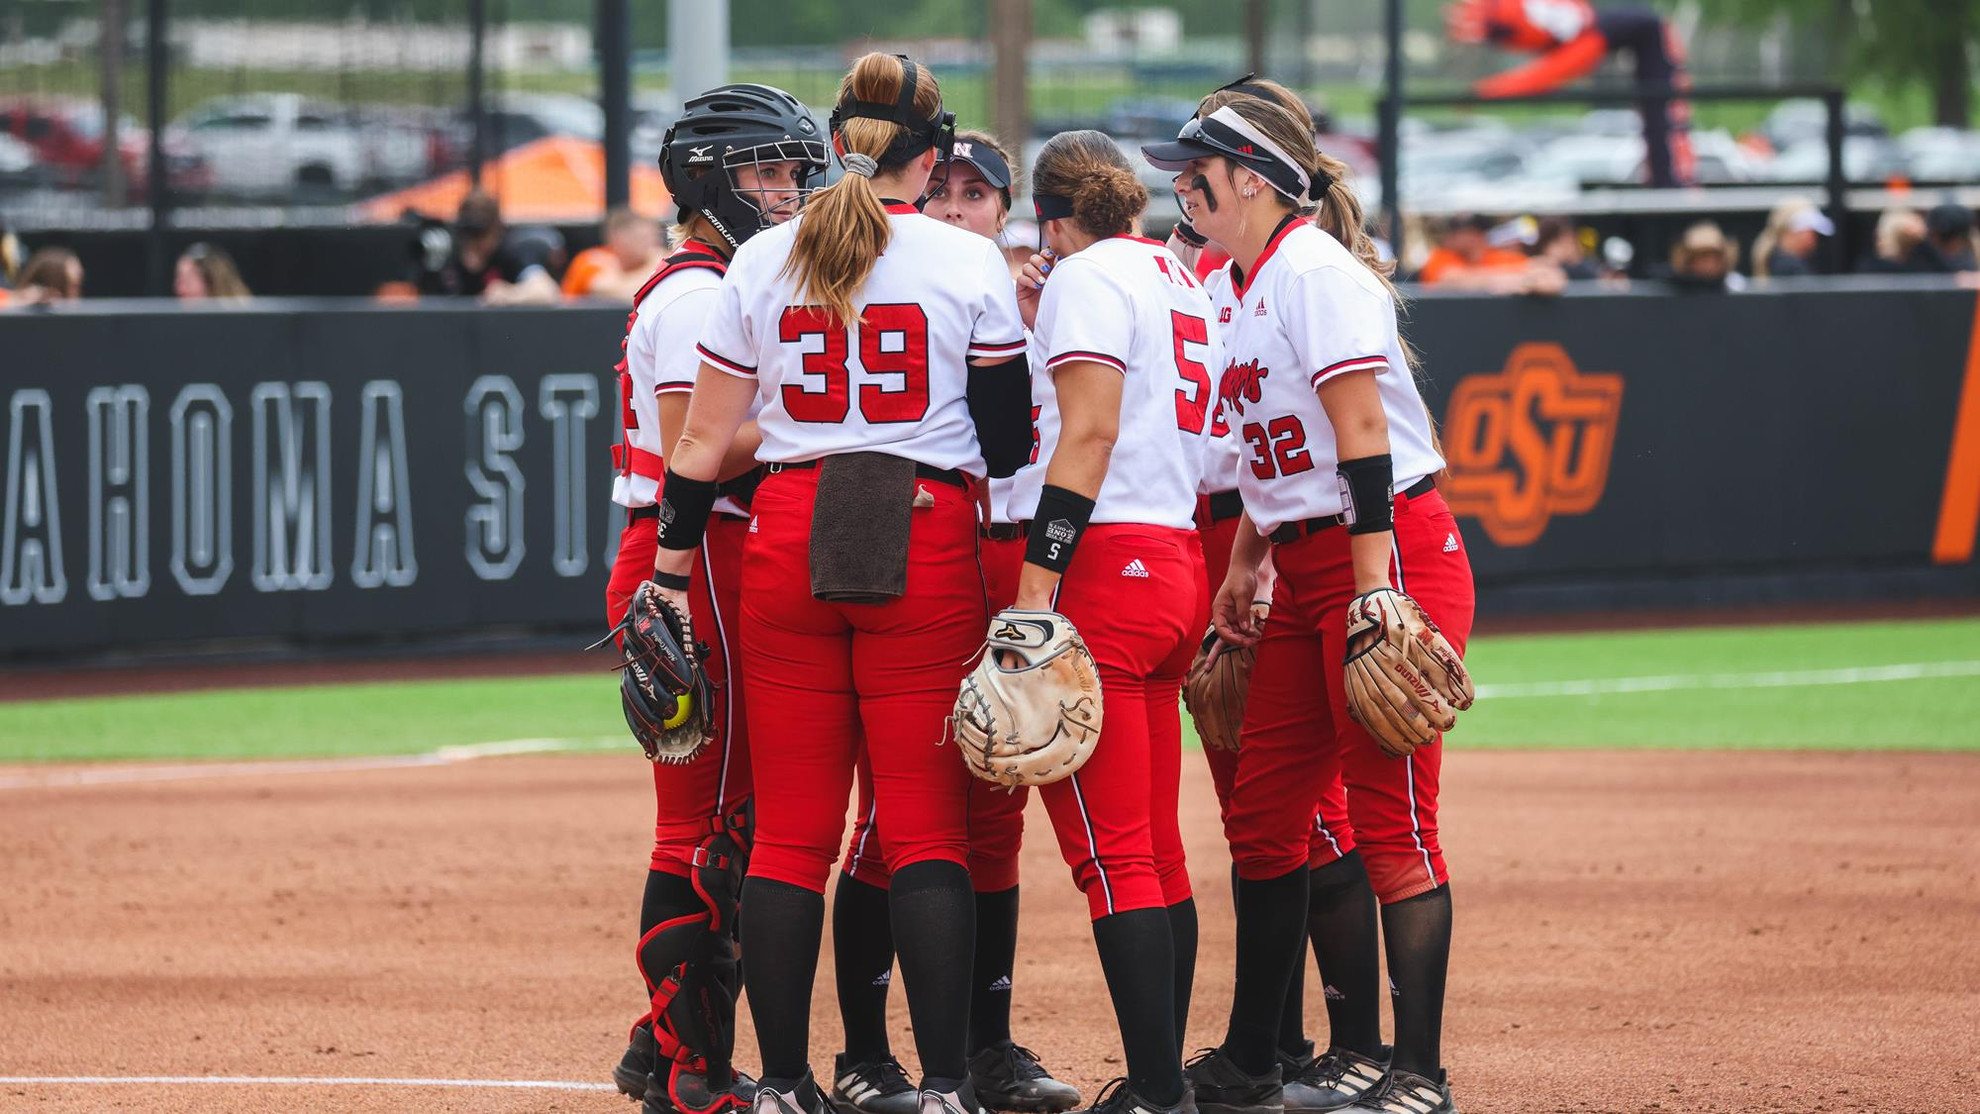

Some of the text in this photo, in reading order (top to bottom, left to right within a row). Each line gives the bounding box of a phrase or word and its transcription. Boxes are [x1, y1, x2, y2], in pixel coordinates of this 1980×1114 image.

[952, 142, 974, 158] N
[778, 302, 931, 425] 39
[1169, 308, 1212, 437] 5
[1242, 414, 1316, 480] 32
[1443, 343, 1625, 547] OSU
[2, 380, 419, 606] AHOMA
[1046, 542, 1062, 561] 5
[1047, 526, 1074, 541] ZONE
[1121, 569, 1150, 578] adidas
